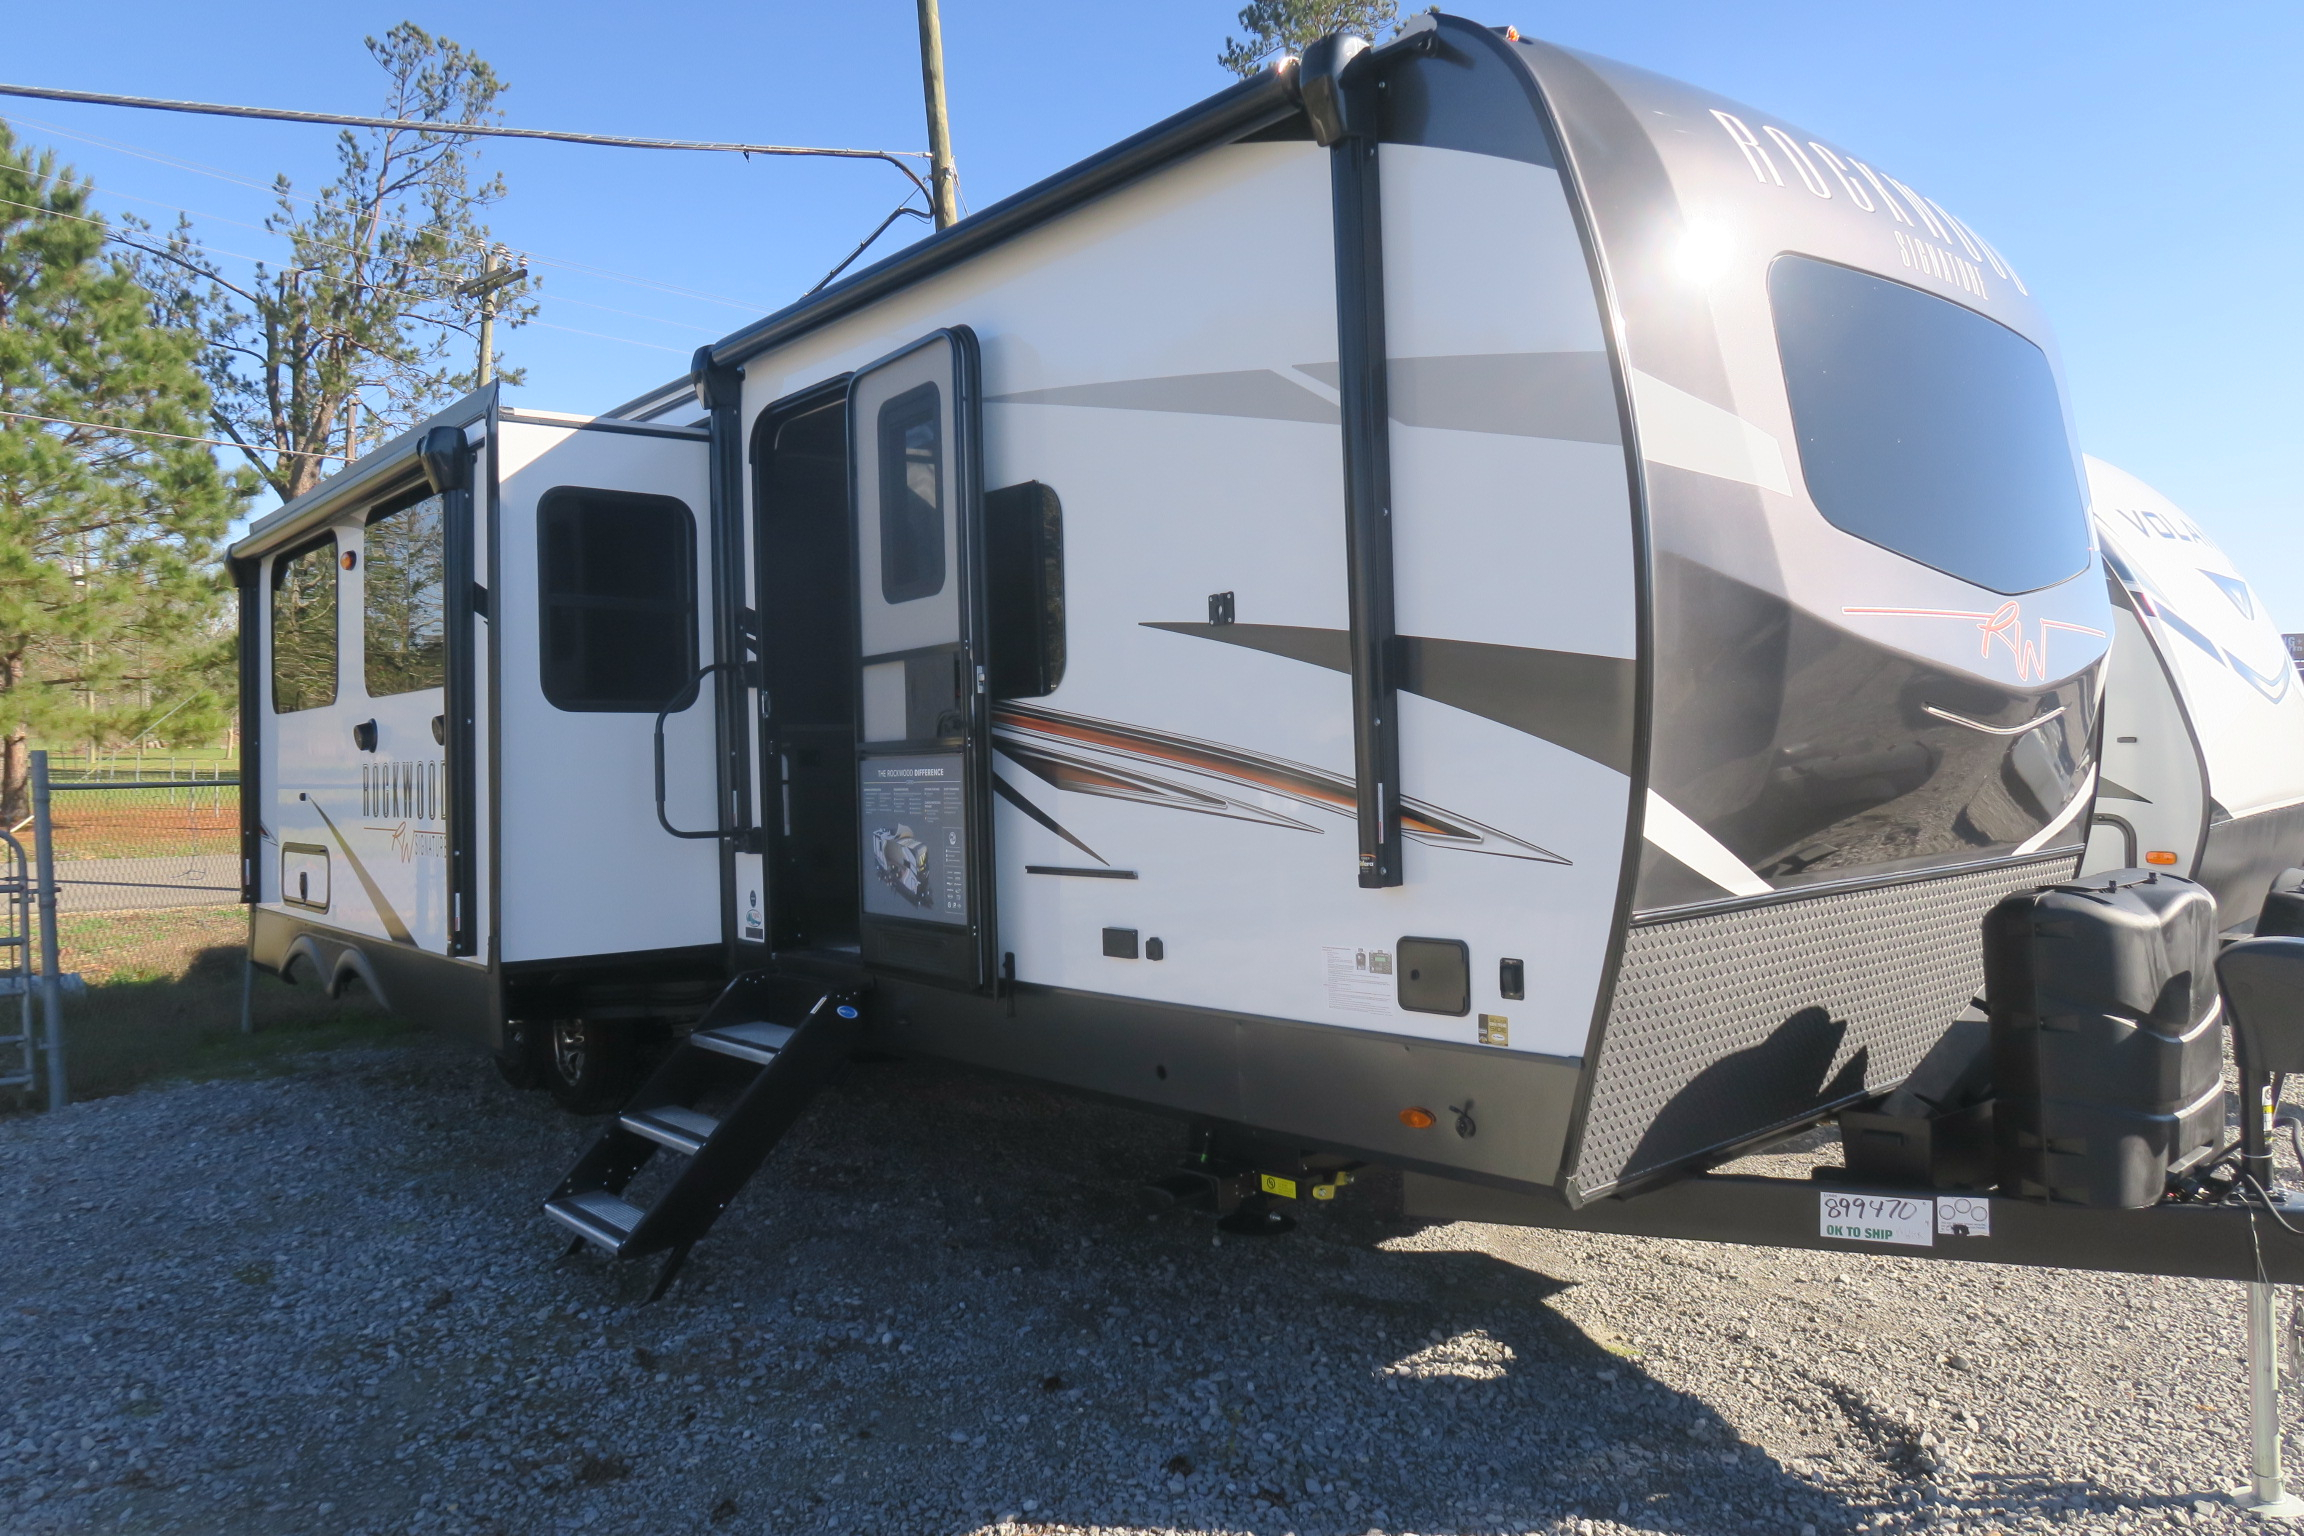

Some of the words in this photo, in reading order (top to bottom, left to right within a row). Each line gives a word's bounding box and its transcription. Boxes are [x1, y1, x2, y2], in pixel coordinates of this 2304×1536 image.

[1708, 108, 2029, 297] ROCKWOOD
[1893, 229, 1989, 300] SIGNATURE
[363, 760, 447, 821] ROCKWOOD
[878, 769, 887, 777] THE
[887, 769, 914, 777] ROCKWOOD
[914, 768, 944, 776] DIFFERENCE
[1825, 1197, 1917, 1221] 899470
[1826, 1224, 1844, 1236] OK
[1846, 1226, 1861, 1238] TO
[1864, 1227, 1893, 1240] SHIP
